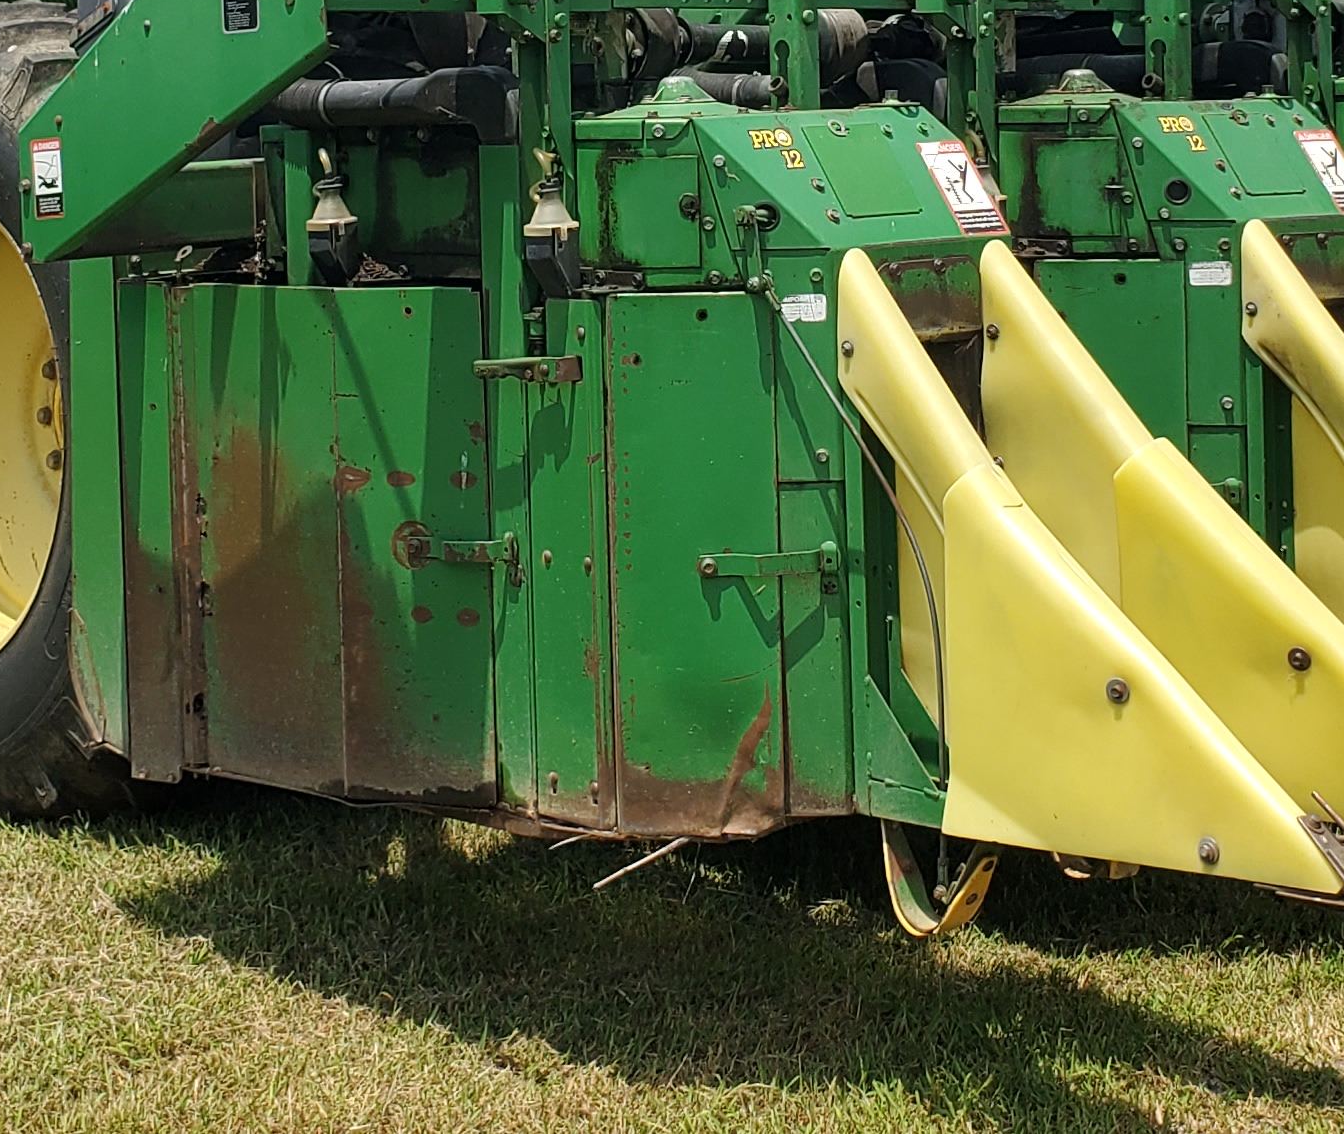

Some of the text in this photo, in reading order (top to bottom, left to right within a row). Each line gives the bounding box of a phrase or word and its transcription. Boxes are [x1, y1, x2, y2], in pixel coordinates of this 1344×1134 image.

[1157, 115, 1195, 133] PRO
[747, 127, 793, 150] PRO
[1185, 134, 1208, 152] 12
[780, 148, 806, 170] 12
